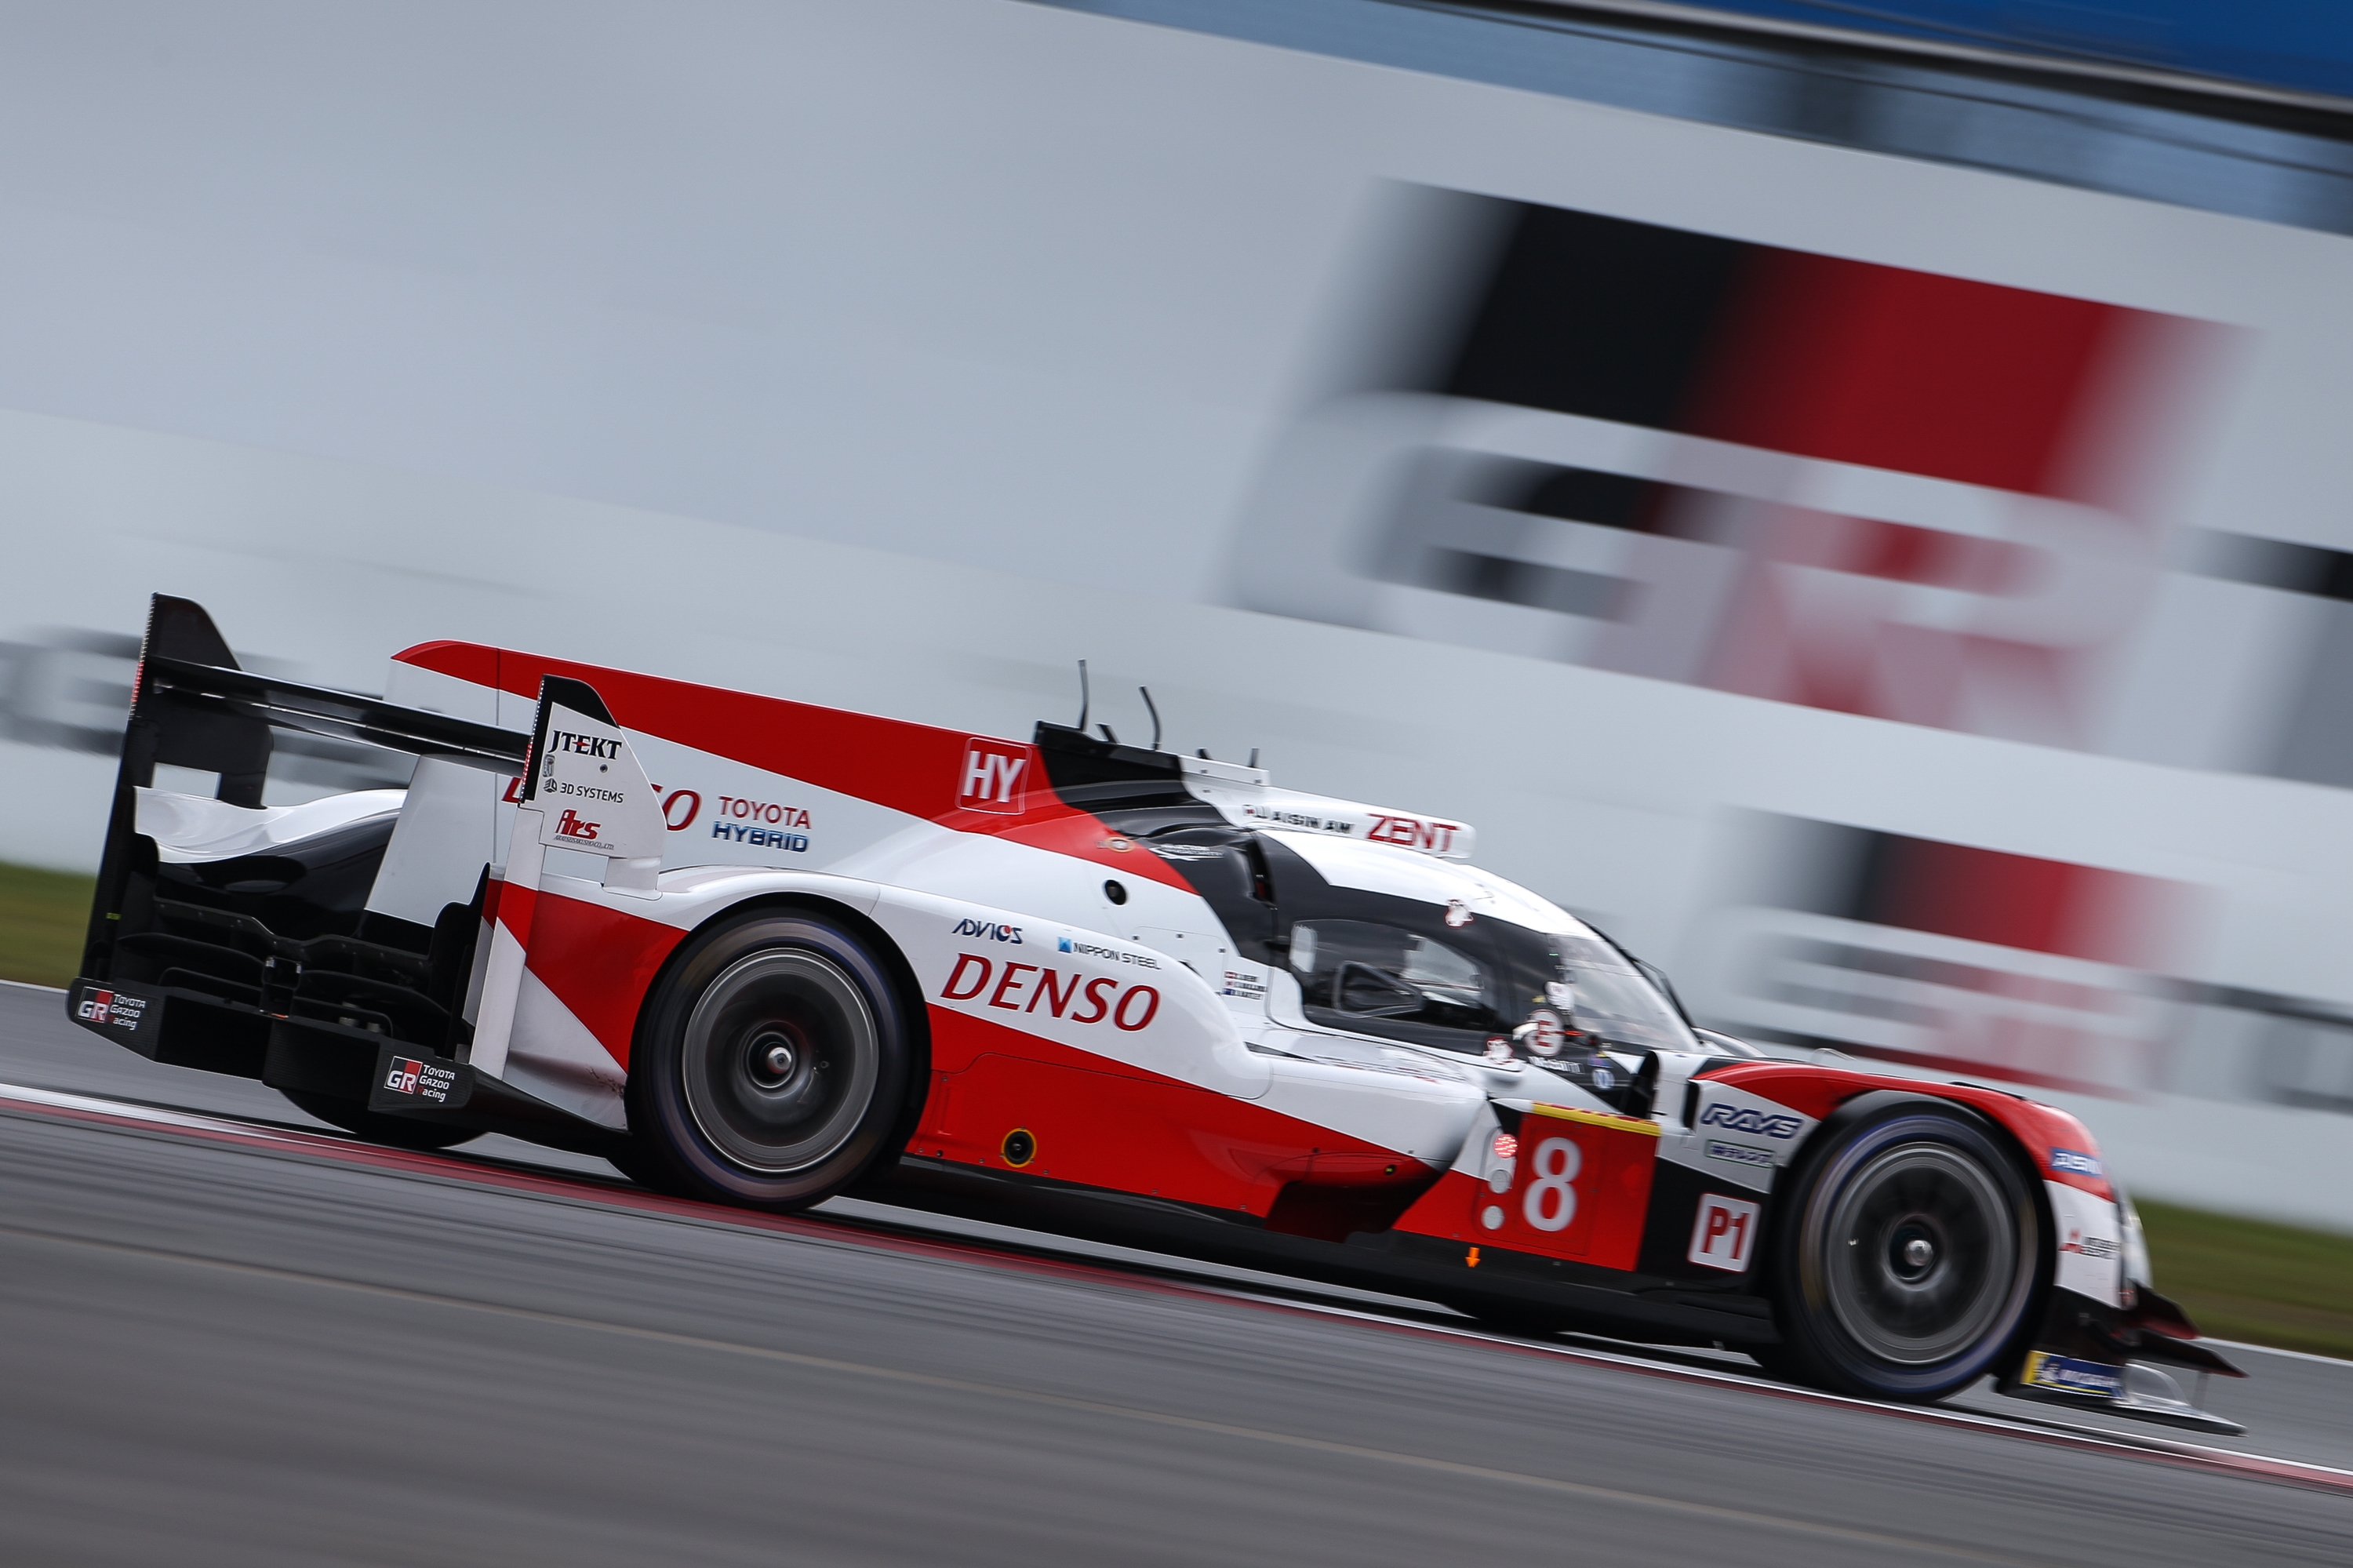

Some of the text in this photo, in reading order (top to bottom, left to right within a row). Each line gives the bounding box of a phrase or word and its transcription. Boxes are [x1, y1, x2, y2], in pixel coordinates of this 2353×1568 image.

[547, 729, 622, 760] JTEKT
[961, 750, 1026, 804] HY
[560, 782, 624, 803] 3D SYSTEMS
[718, 795, 812, 829] TOYOTA
[711, 820, 809, 853] HYBRID
[1366, 813, 1461, 853] ZENT
[951, 918, 1023, 944] ADVICS
[1073, 941, 1162, 970] NIPPON STEEL
[114, 994, 147, 1009] TOYOTA
[940, 952, 1162, 1032] DENSO
[78, 1000, 110, 1021] GR
[110, 1004, 141, 1018] GAZOO
[387, 1070, 417, 1092] GR
[419, 1075, 450, 1090] GAZOO
[424, 1064, 455, 1080] TOYOTA
[416, 1085, 446, 1102] Racing
[1700, 1102, 1804, 1140] RAYS
[1522, 1137, 1582, 1232] 8
[1699, 1205, 1750, 1261] P1
